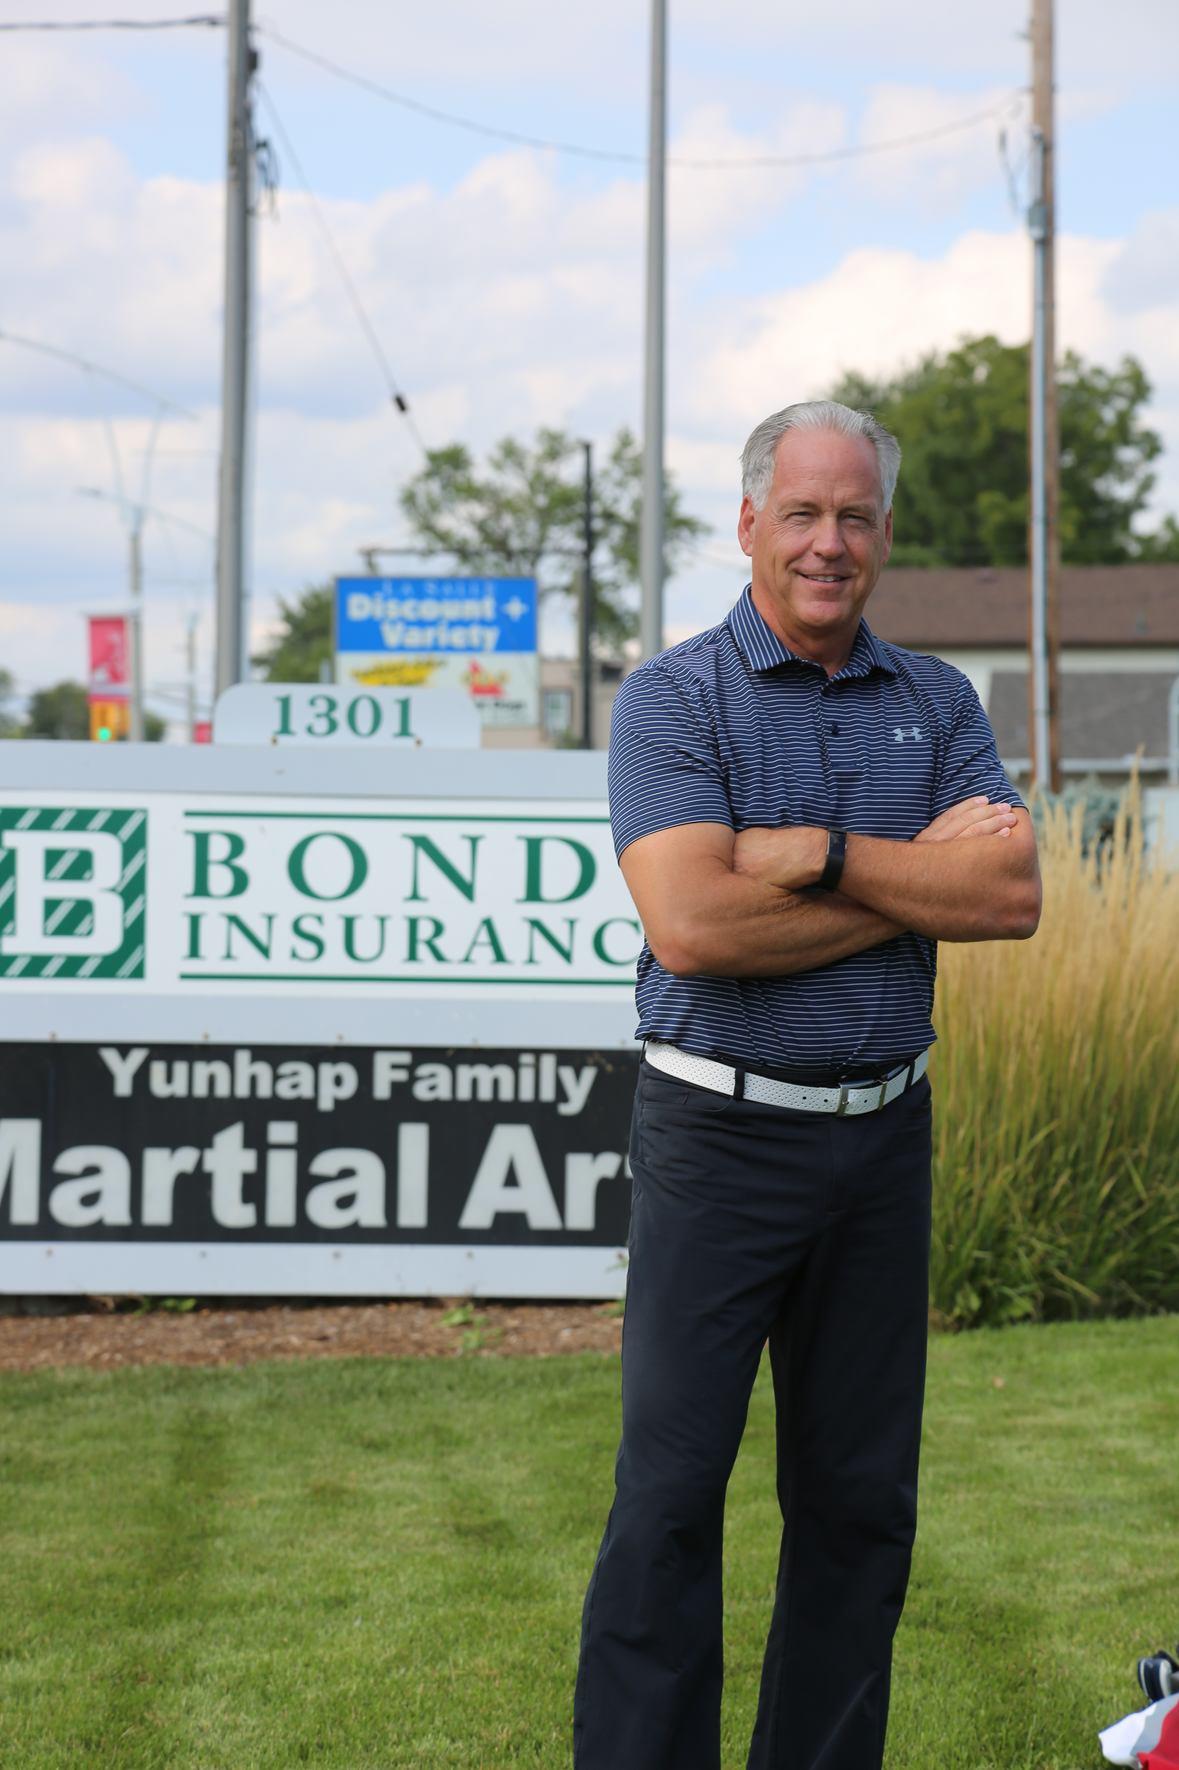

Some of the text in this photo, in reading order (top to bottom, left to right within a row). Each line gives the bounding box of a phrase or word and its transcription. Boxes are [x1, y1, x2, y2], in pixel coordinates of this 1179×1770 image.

[347, 592, 496, 621] Discount
[379, 620, 500, 652] Variety
[274, 694, 415, 738] 1301
[184, 830, 598, 904] BOND
[99, 1047, 598, 1116] Yunhap Family
[458, 1123, 632, 1231] Ar
